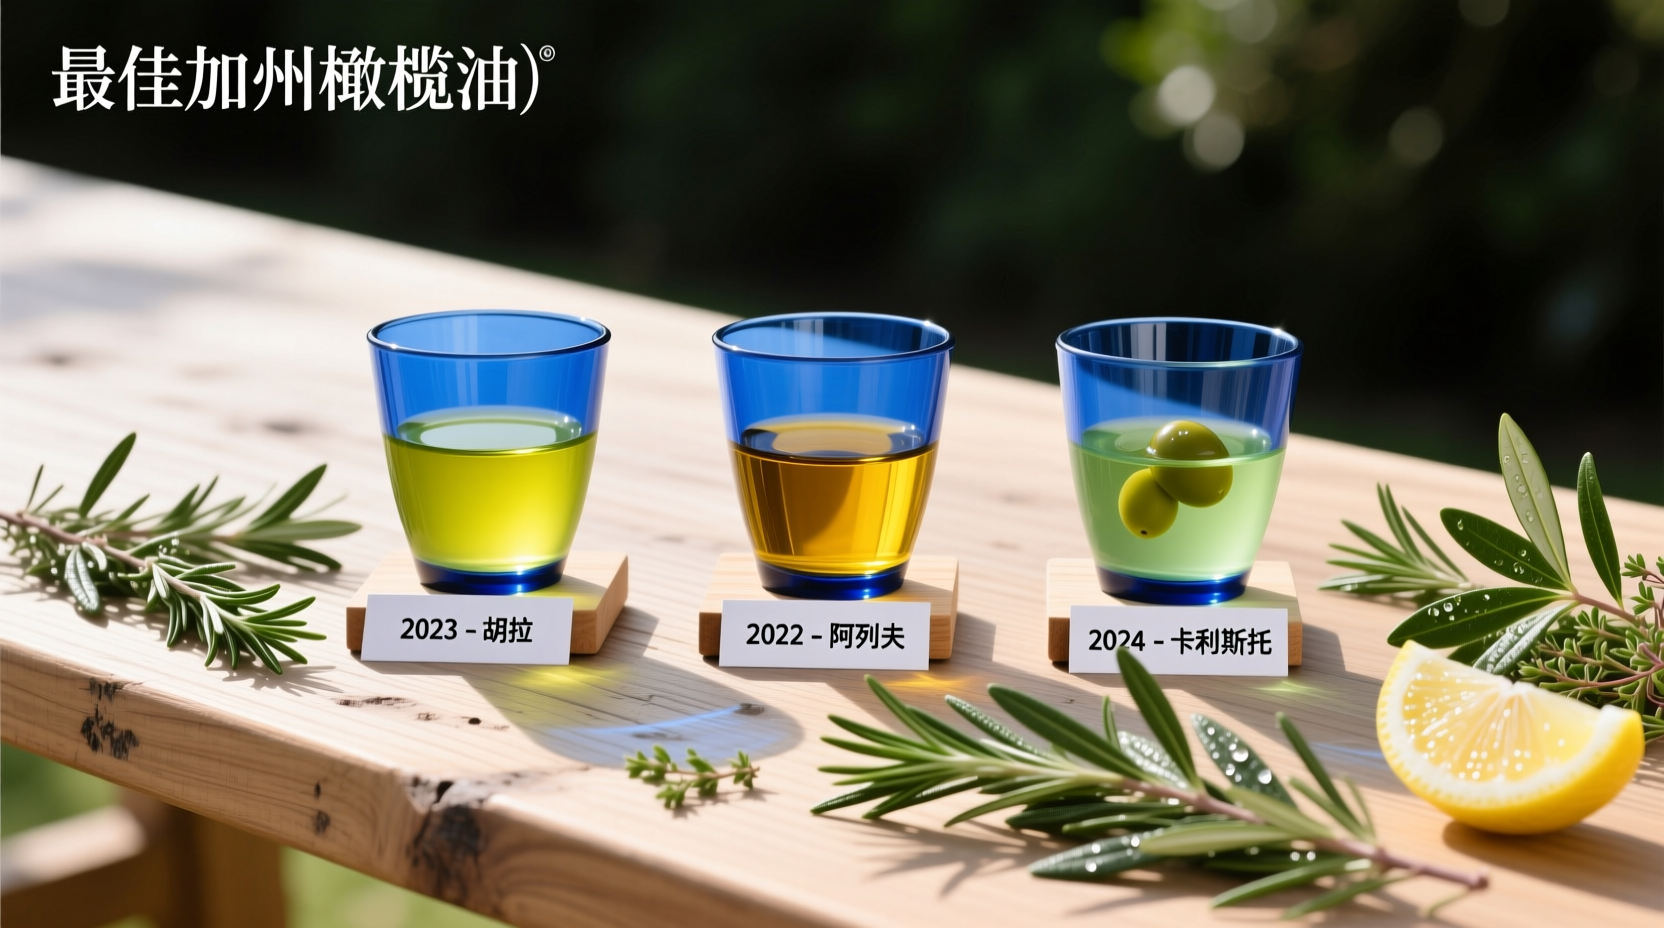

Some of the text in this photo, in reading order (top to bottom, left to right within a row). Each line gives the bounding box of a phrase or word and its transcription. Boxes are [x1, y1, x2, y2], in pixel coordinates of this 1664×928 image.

[400, 617, 457, 640] 2023
[482, 616, 533, 643] 胡拉
[746, 622, 803, 645] 2022
[829, 622, 905, 649] 阿列夫
[1088, 629, 1145, 651] 2024
[1170, 627, 1272, 655] 卡利斯托
